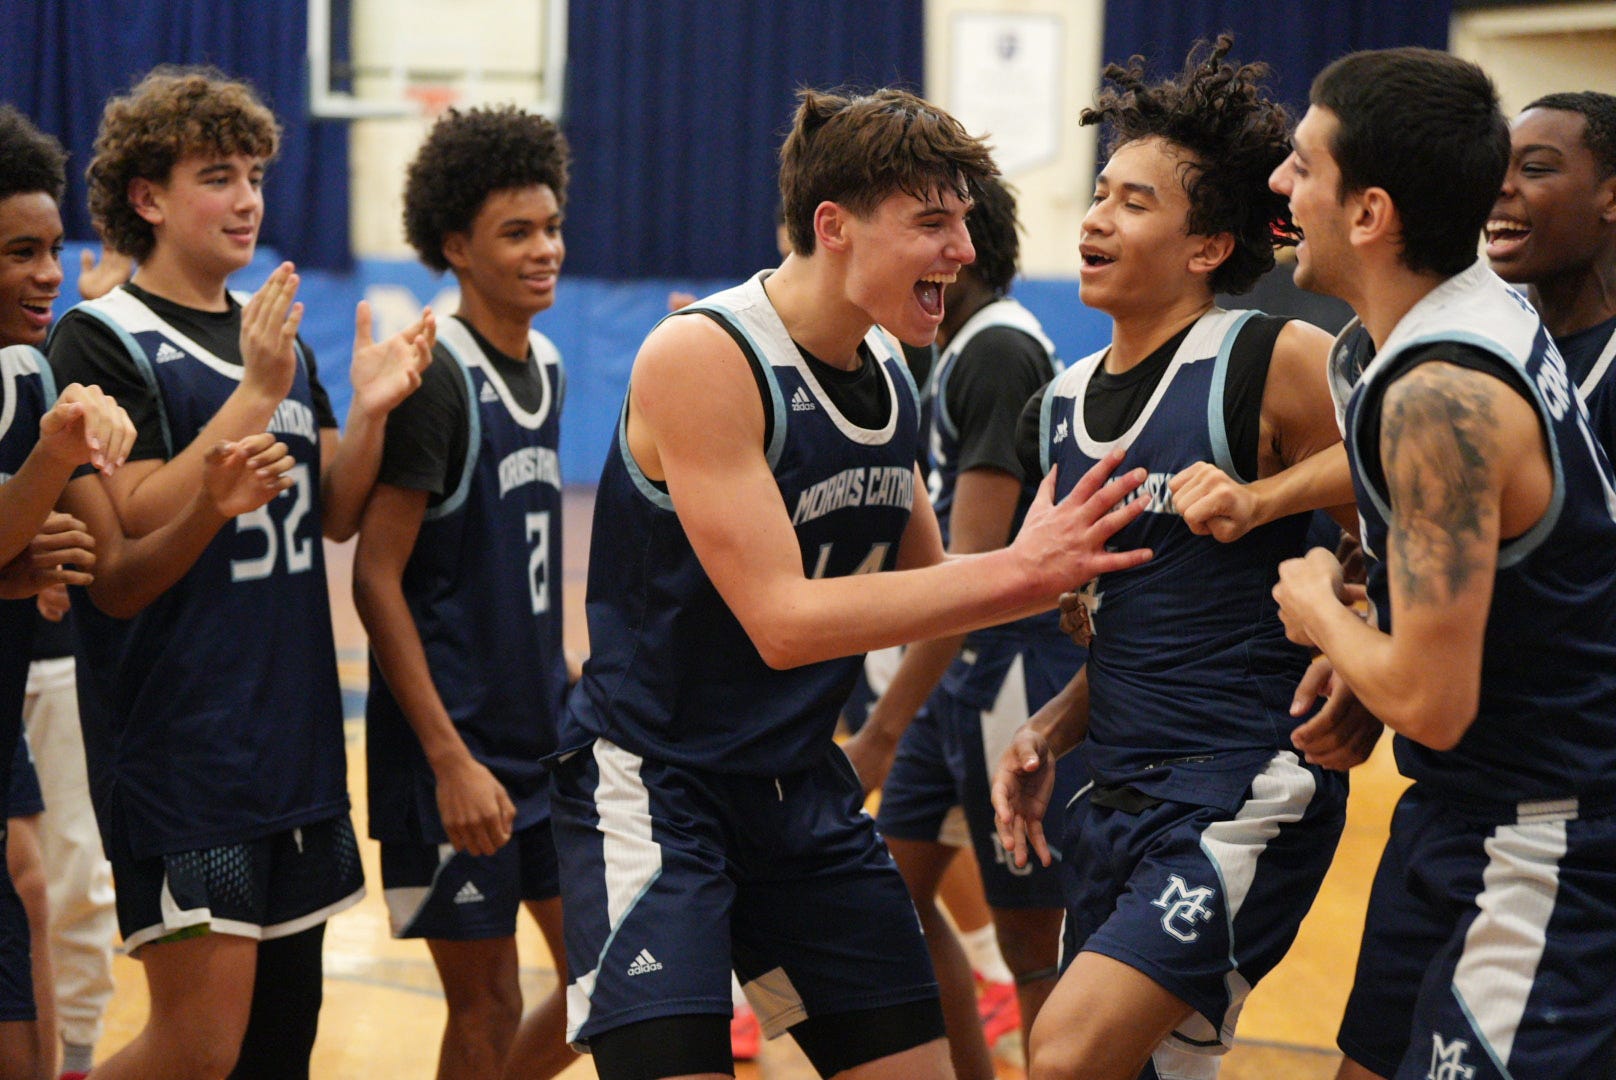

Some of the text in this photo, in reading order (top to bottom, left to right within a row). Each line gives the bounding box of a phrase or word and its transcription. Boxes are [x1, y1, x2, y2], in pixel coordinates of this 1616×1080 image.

[793, 467, 865, 527] MORRIS
[525, 510, 550, 615] 2
[1150, 873, 1215, 944] MC
[627, 962, 663, 976] adidas
